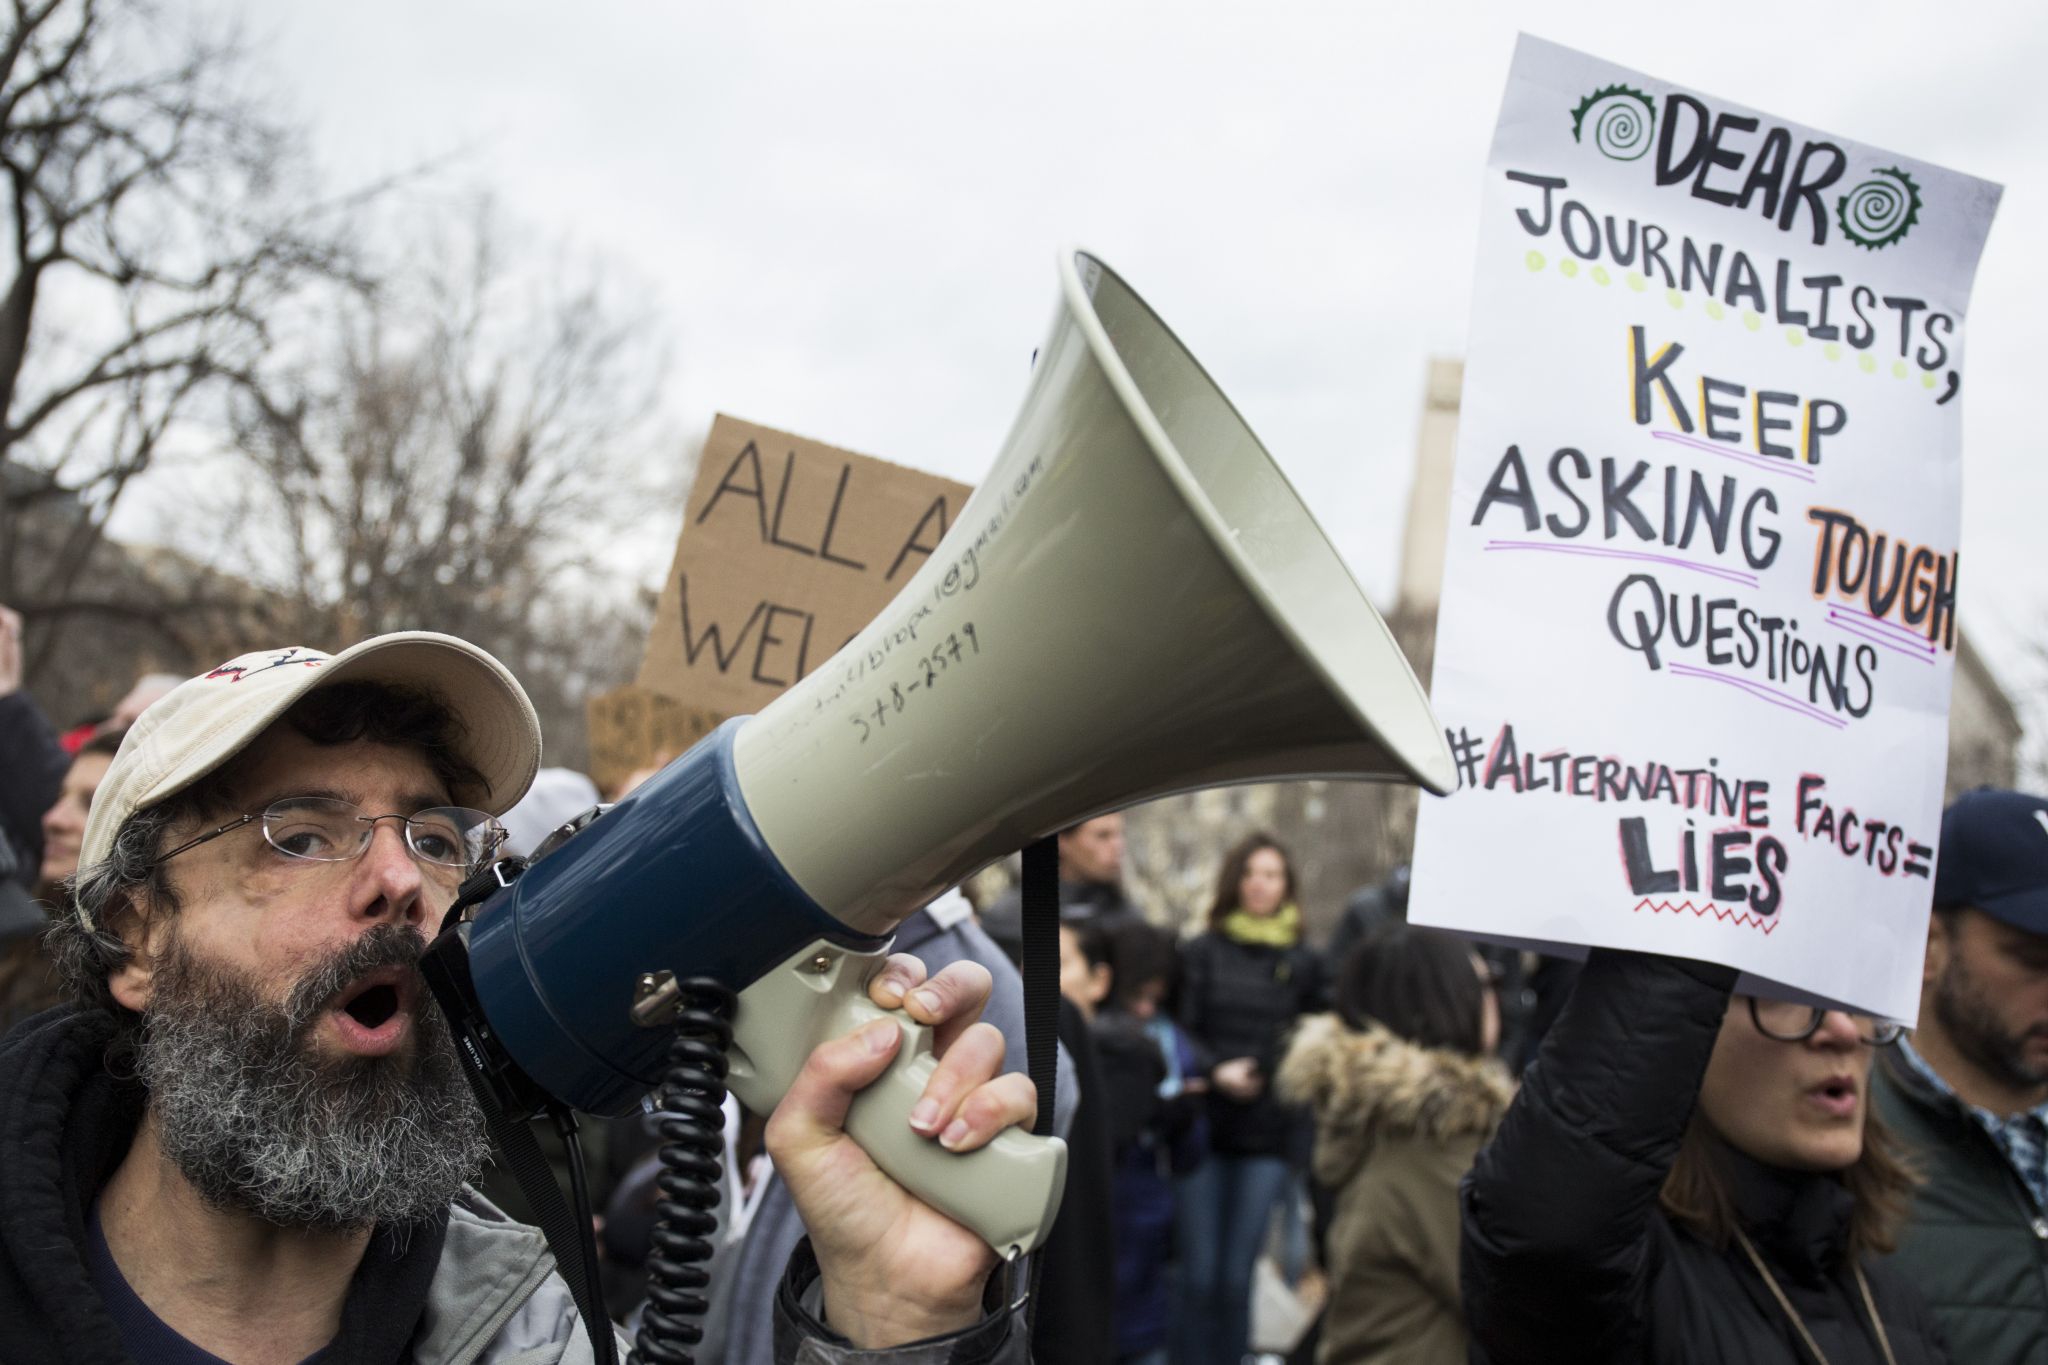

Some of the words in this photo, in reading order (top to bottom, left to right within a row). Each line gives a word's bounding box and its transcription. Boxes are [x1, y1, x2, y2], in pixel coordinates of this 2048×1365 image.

[1655, 93, 1847, 245] DEAR
[1505, 170, 1961, 405] JOURNALISTS,
[1629, 324, 1847, 465] KEEP
[695, 439, 867, 571] ALL
[1471, 444, 1782, 570] ASKING
[1808, 505, 1959, 652] TOUGH
[462, 1035, 483, 1070] VOLUME
